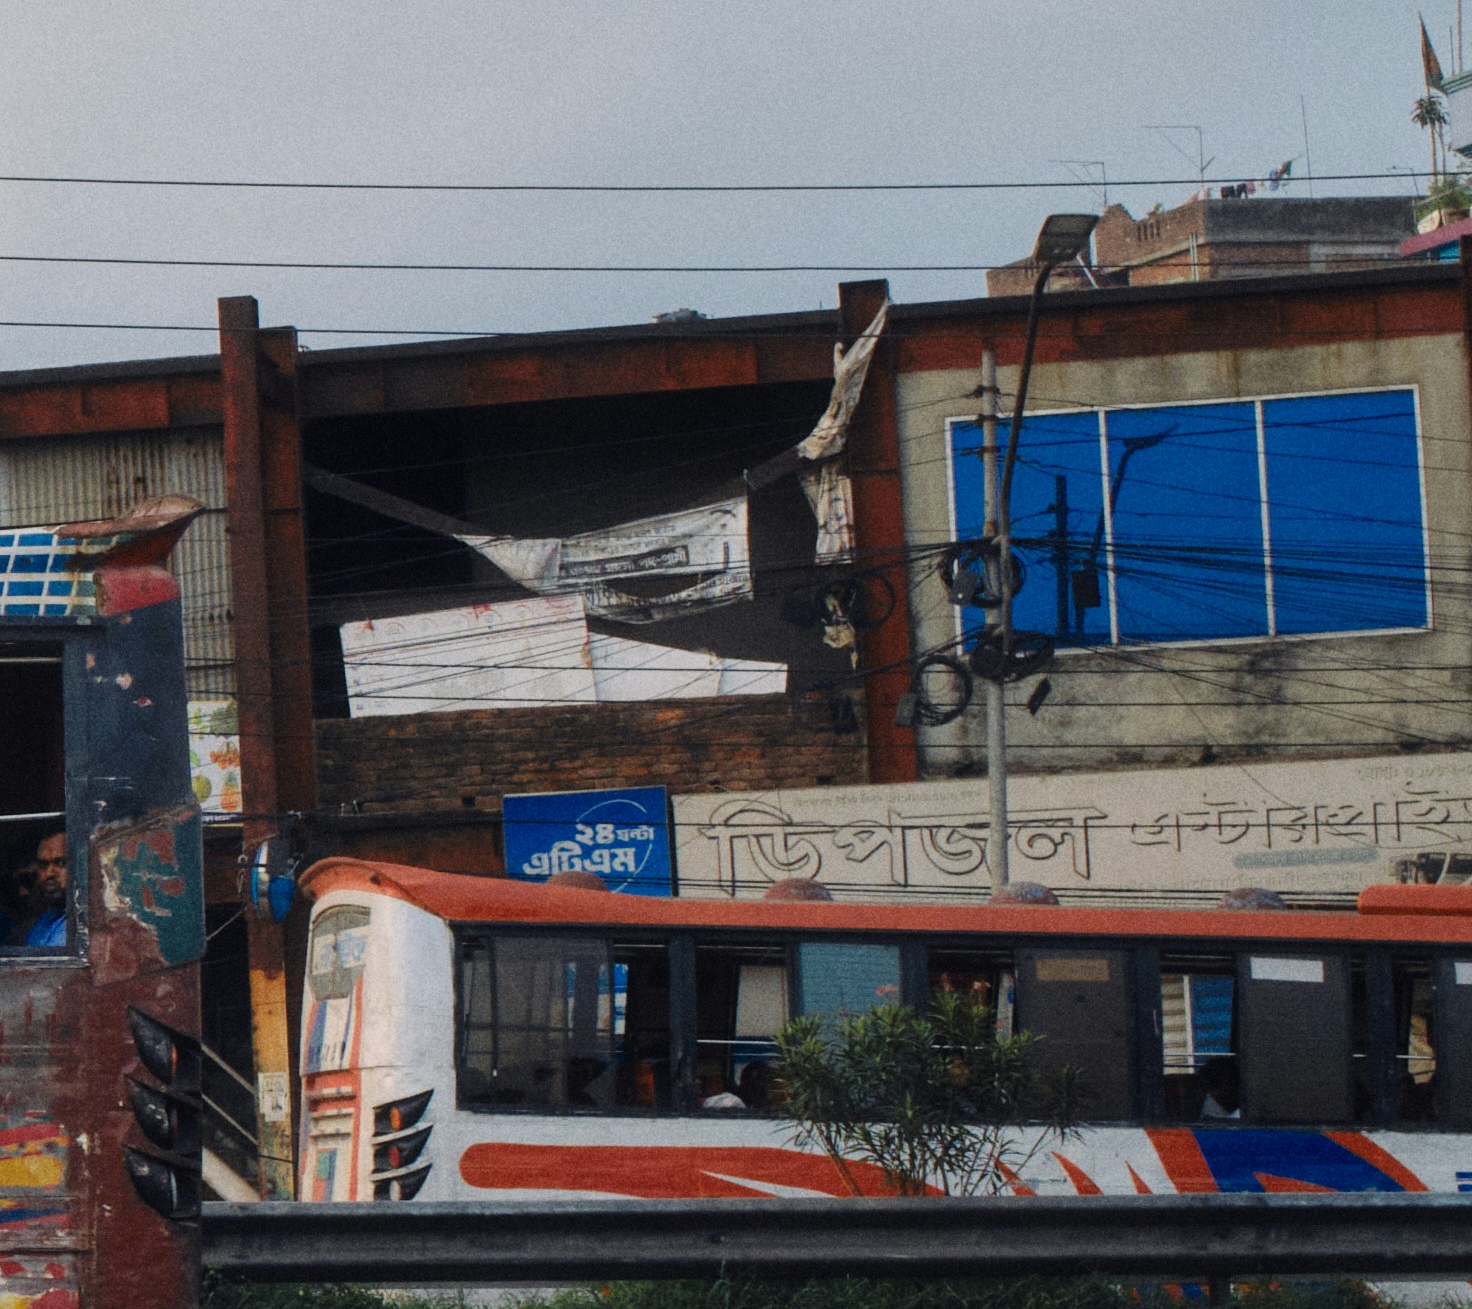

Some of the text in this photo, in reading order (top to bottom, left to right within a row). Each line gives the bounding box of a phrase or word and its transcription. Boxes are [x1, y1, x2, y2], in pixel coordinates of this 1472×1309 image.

[575, 823, 615, 845] ২৪
[697, 781, 1472, 898] ডিপজল এন্টারপ্রাই
[522, 840, 636, 875] এটিএম
